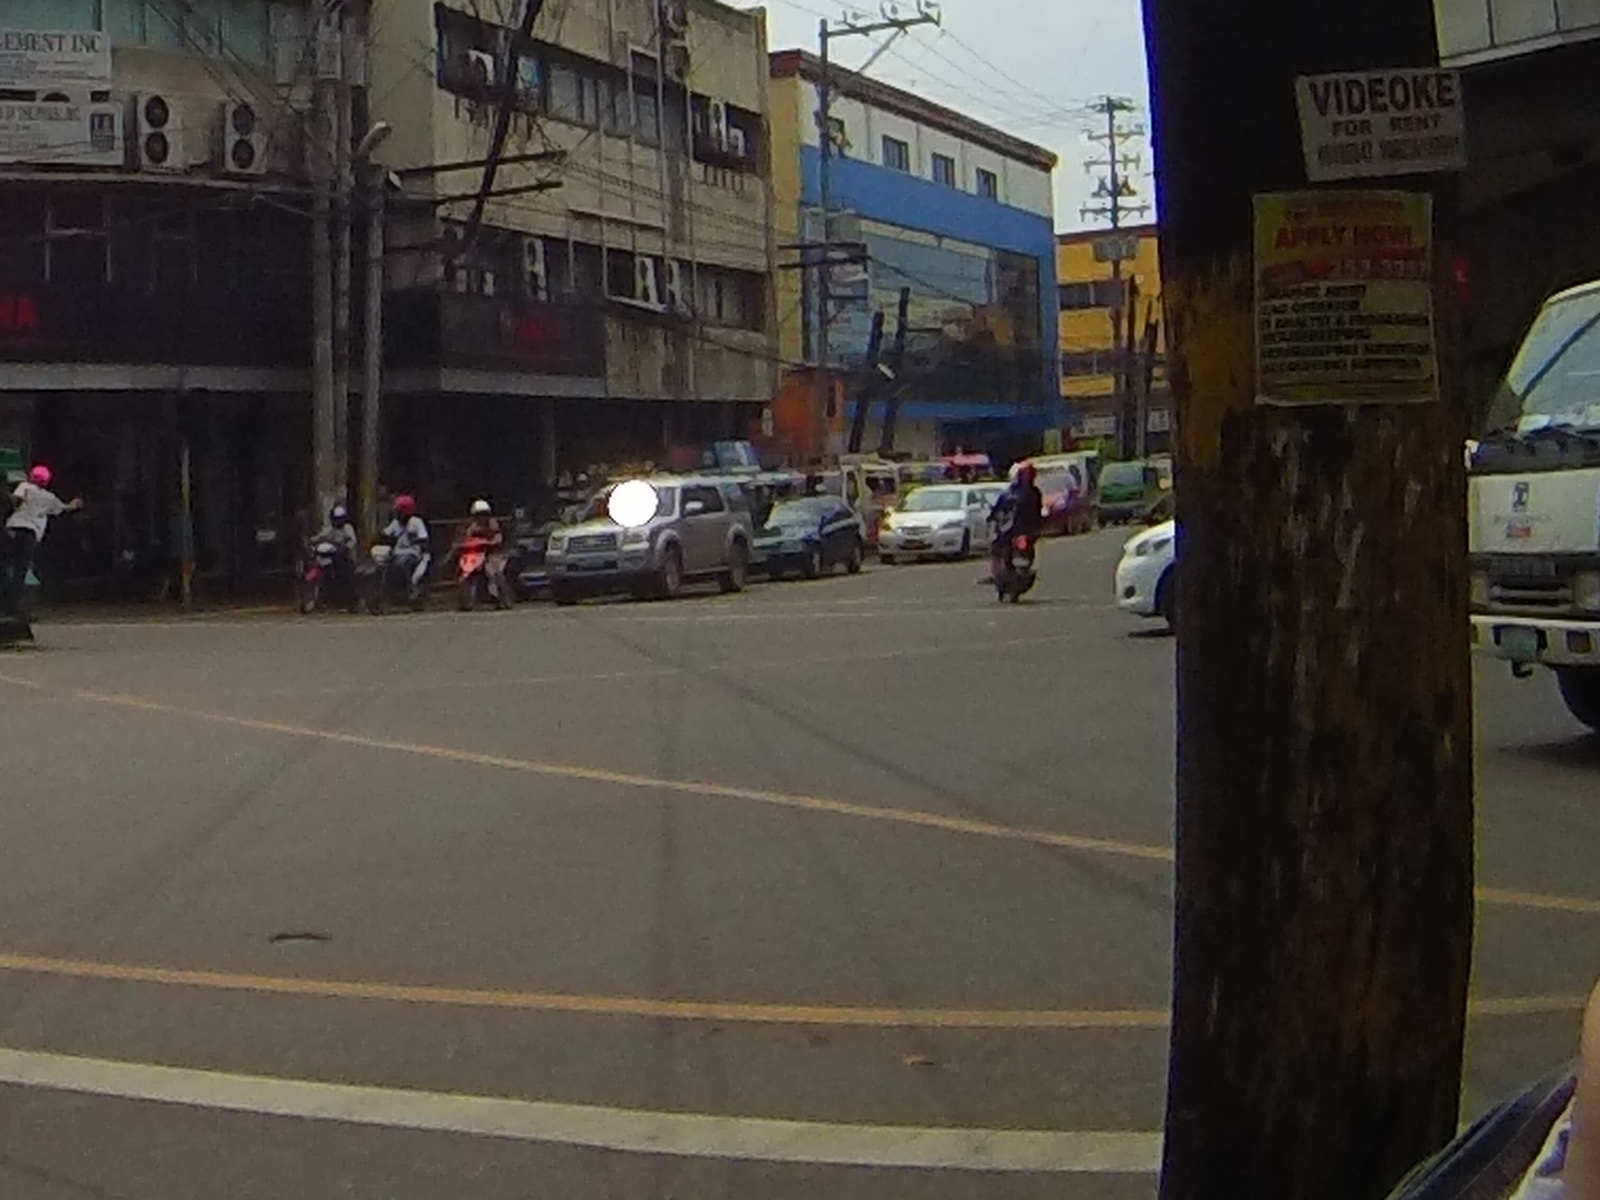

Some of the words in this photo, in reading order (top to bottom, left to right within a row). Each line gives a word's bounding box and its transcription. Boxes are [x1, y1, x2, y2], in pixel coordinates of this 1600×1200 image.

[1309, 73, 1455, 116] VIDEOKE
[1332, 119, 1372, 137] FOR
[1390, 114, 1441, 132] RENT
